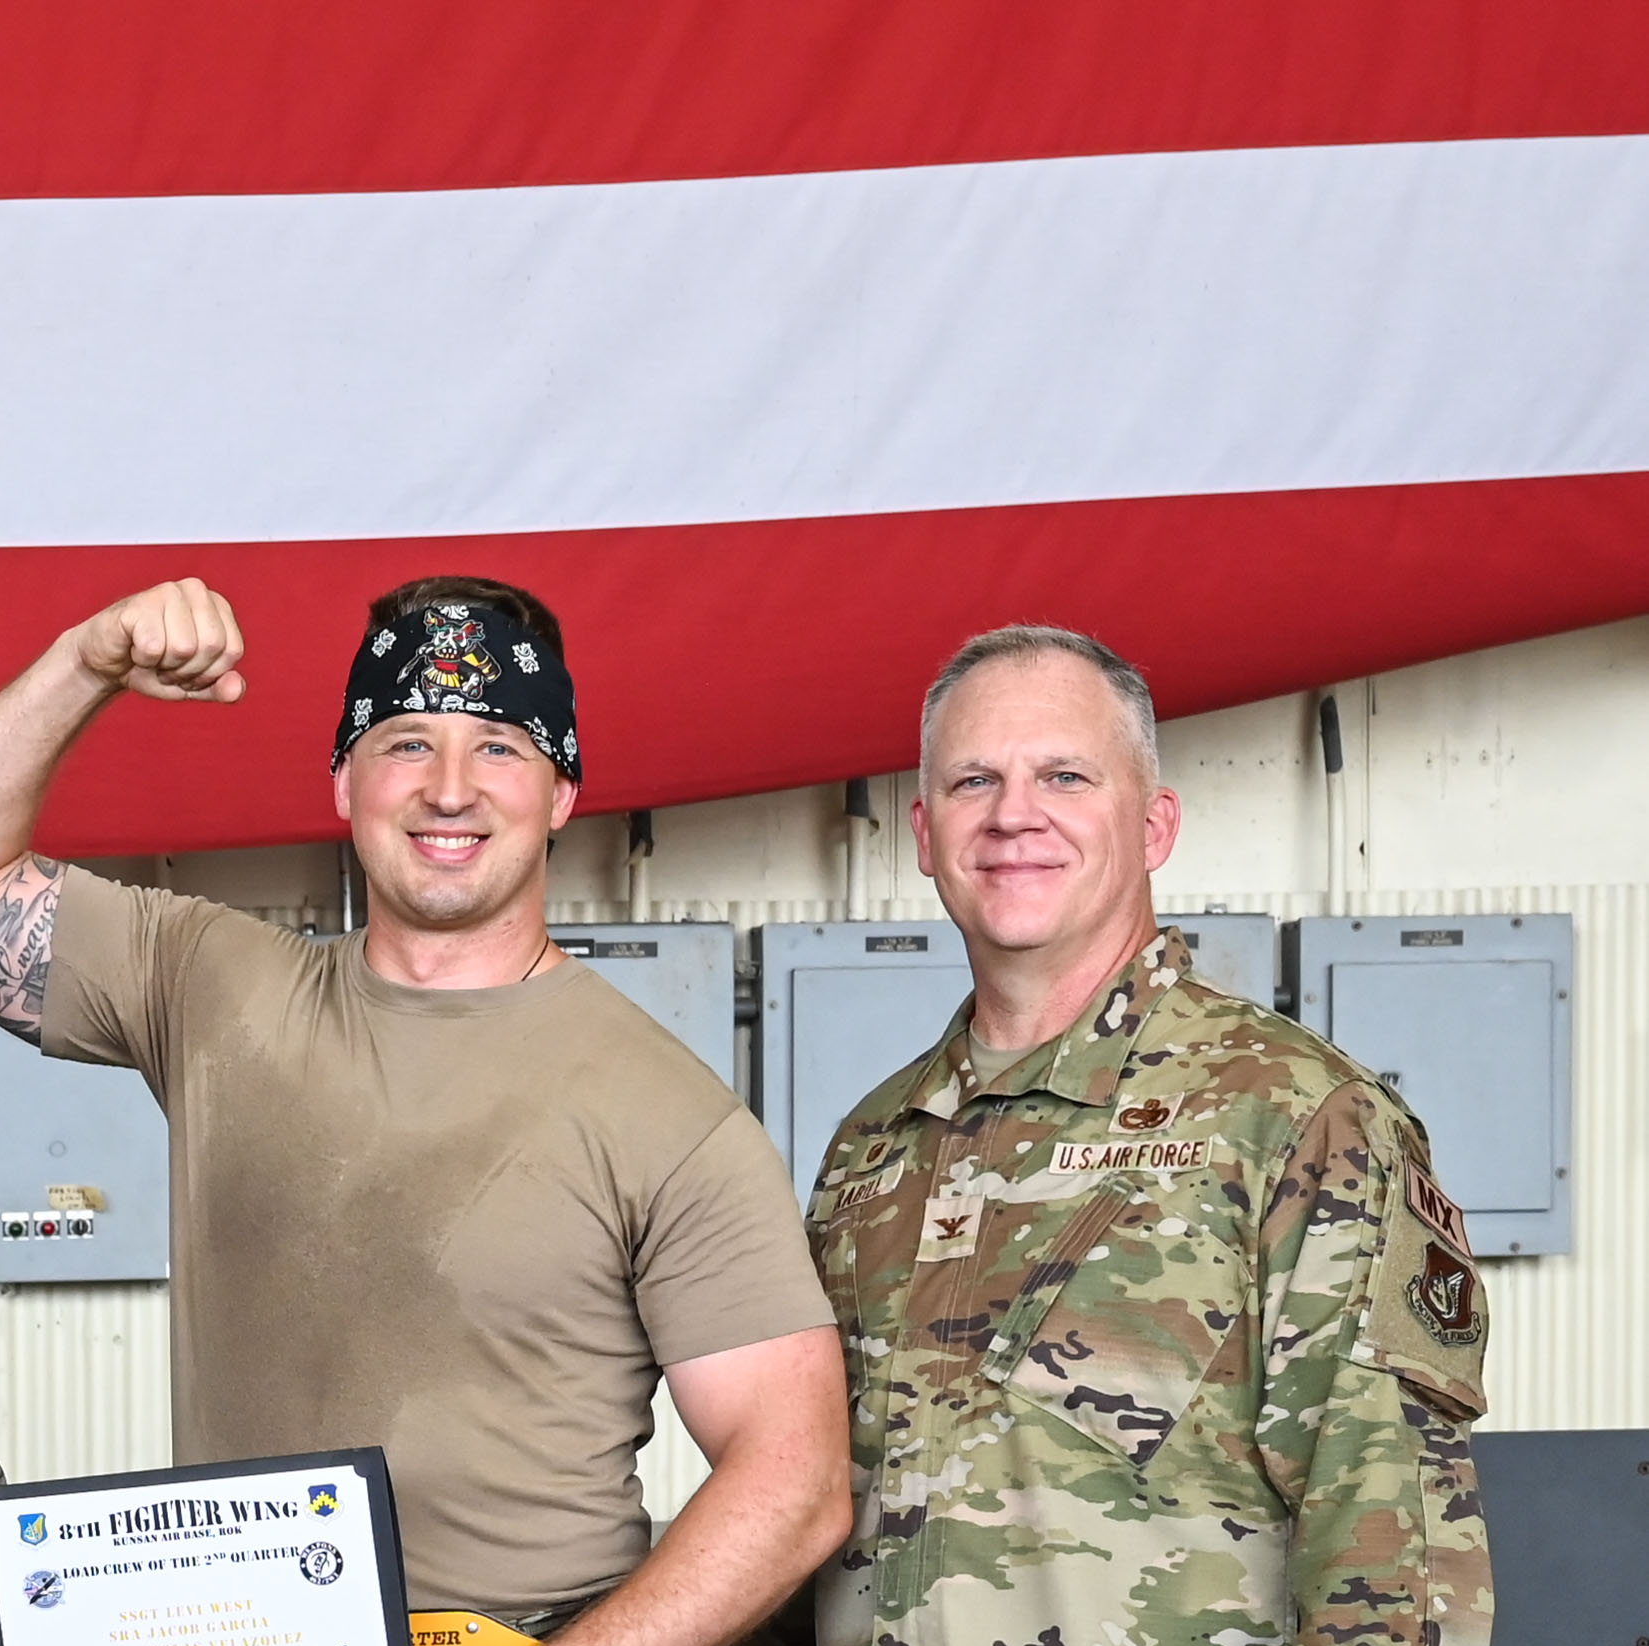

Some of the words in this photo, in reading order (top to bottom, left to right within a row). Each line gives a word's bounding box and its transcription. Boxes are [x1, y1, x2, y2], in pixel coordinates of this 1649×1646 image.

[1059, 1146, 1094, 1170] U.S.
[1097, 1146, 1133, 1168] AIR
[1136, 1142, 1205, 1168] FORCE
[1417, 1174, 1459, 1241] MX
[59, 1522, 101, 1540] 8TH
[109, 1499, 223, 1535] FIGHTER
[229, 1501, 298, 1523] WING
[113, 1535, 157, 1546] KUNSAN
[162, 1533, 181, 1542] AIR
[184, 1529, 215, 1540] BASE,
[63, 1566, 100, 1579] LOAD
[104, 1561, 142, 1575] CREW
[149, 1560, 166, 1571] OF
[170, 1556, 201, 1569] THE
[231, 1547, 300, 1563] QUARTER
[210, 1600, 253, 1613] WEST
[207, 1617, 269, 1633] GARCIA
